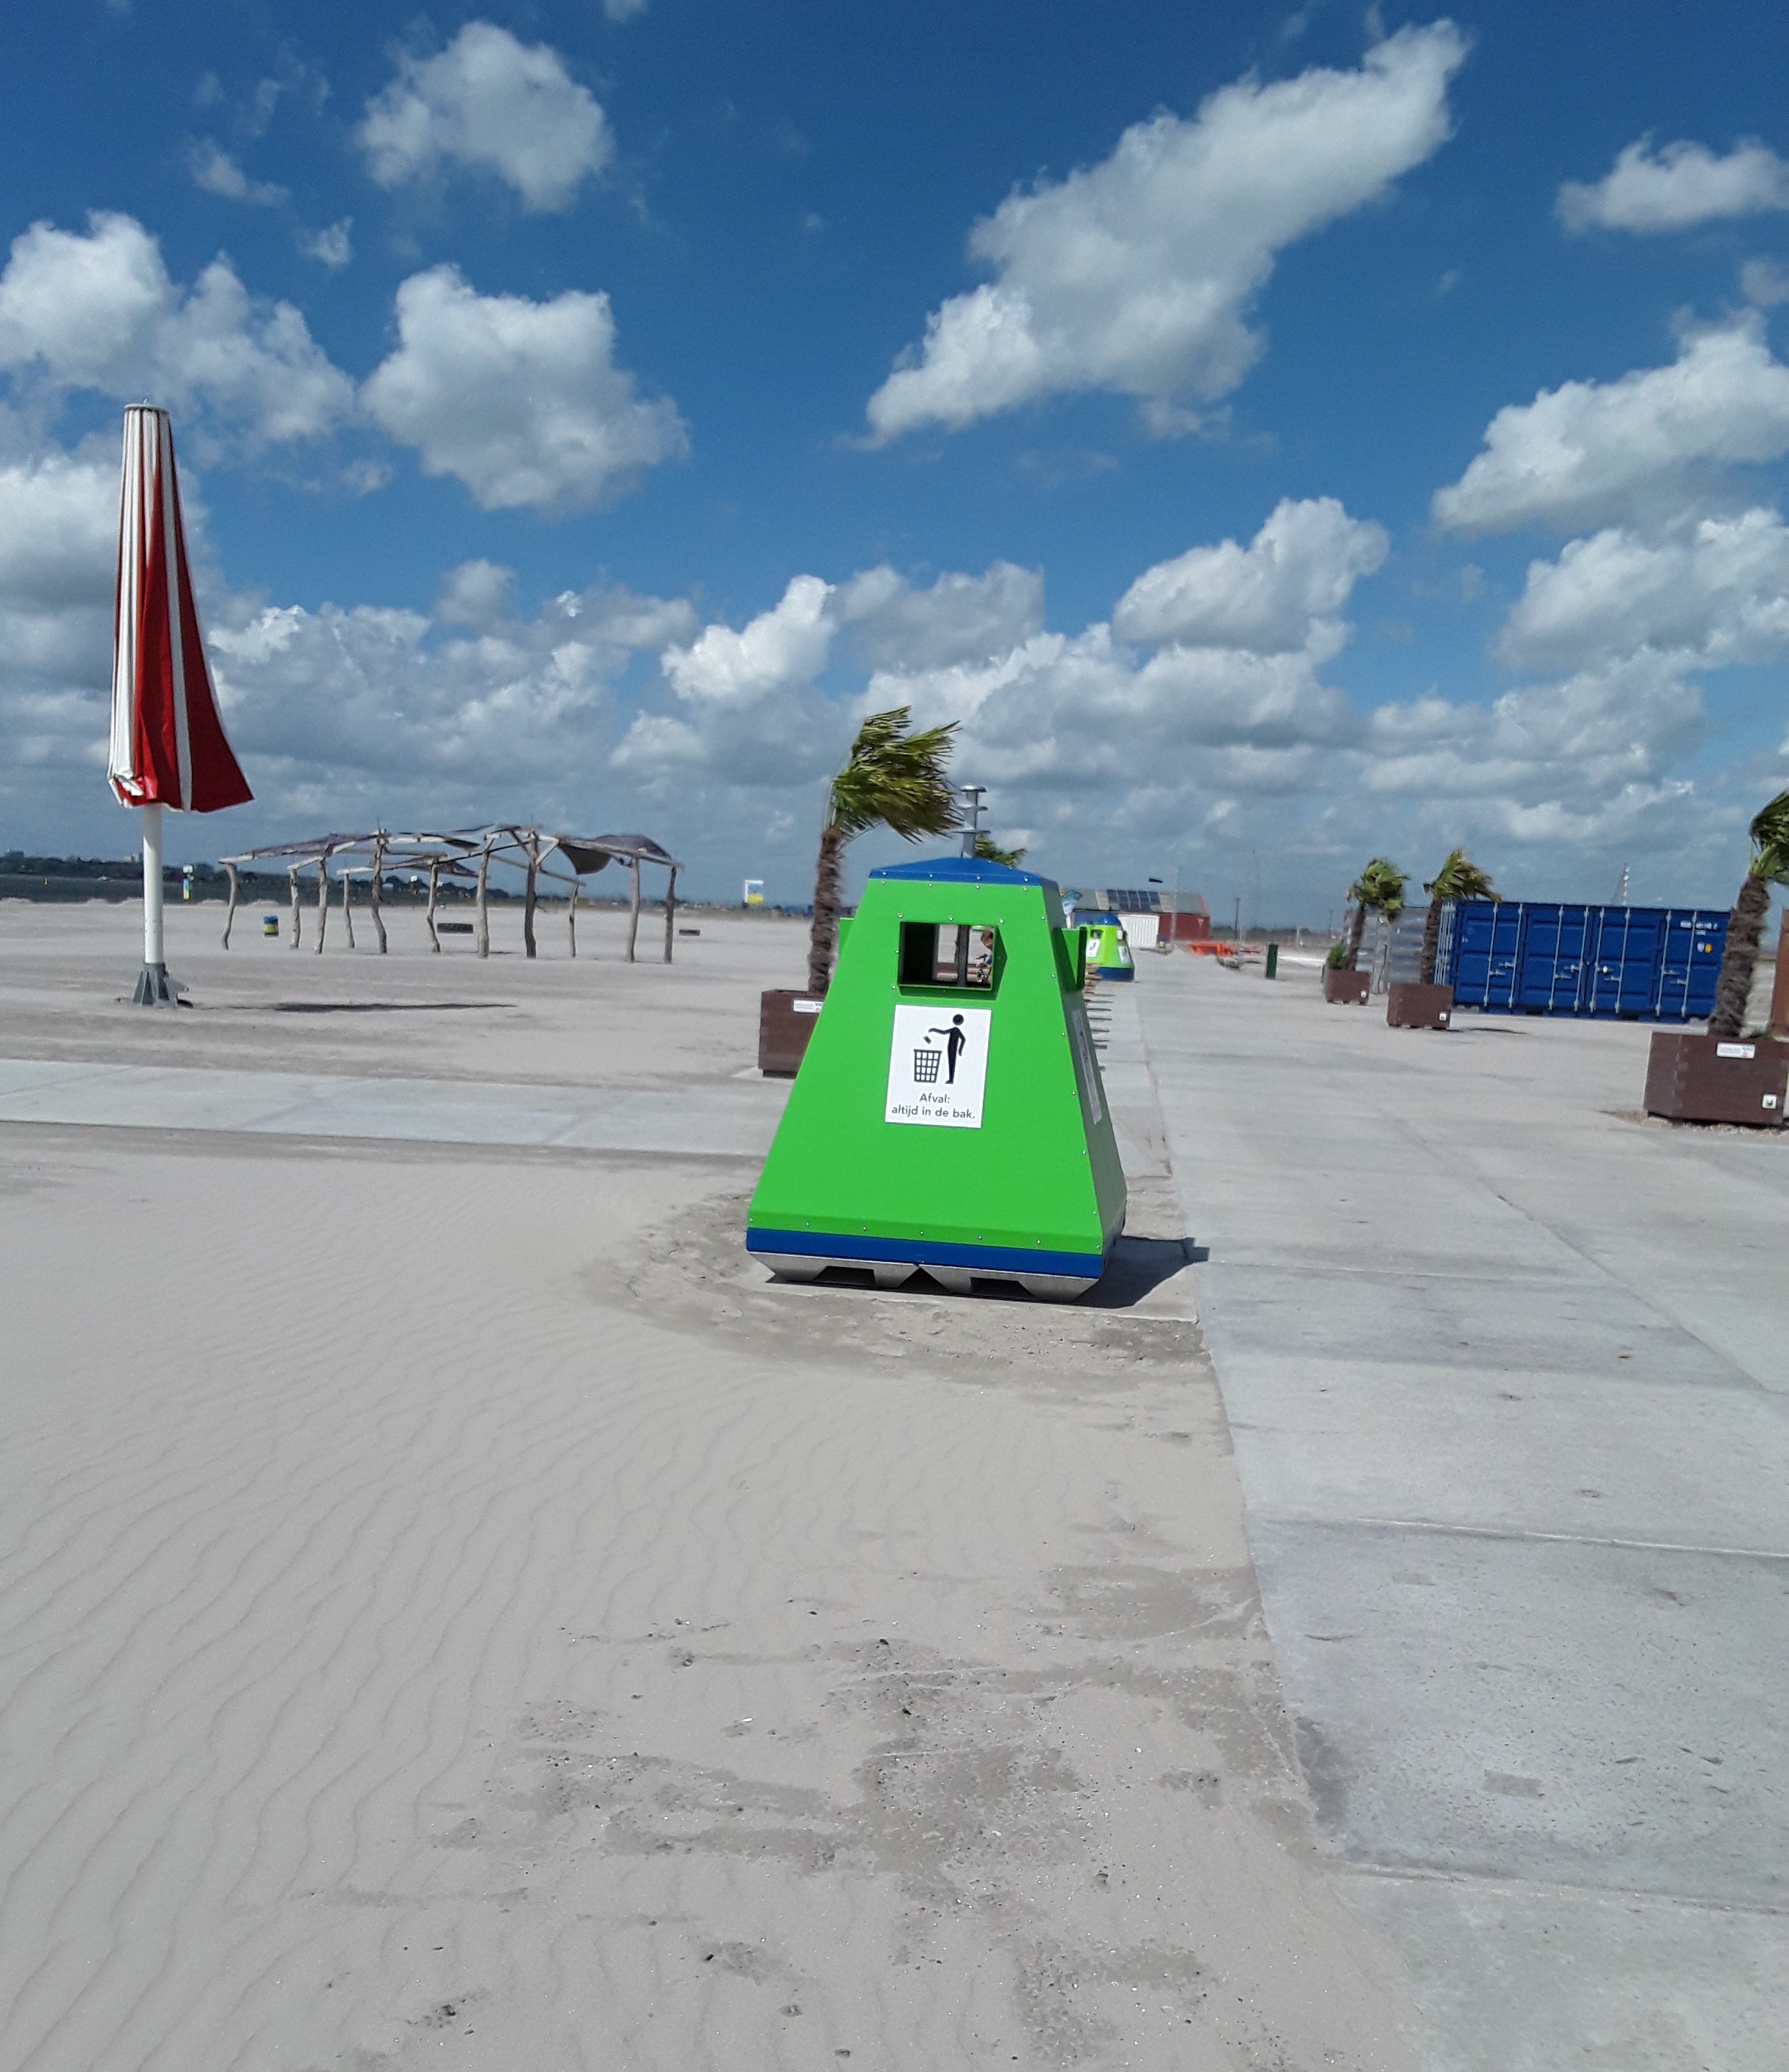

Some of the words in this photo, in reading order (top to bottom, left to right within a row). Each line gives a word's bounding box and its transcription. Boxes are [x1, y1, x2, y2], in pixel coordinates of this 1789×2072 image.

[919, 1093, 951, 1104] Afval:
[891, 1104, 918, 1118] altijd
[921, 1106, 931, 1116] in
[934, 1107, 949, 1118] de
[952, 1108, 975, 1119] bak.
